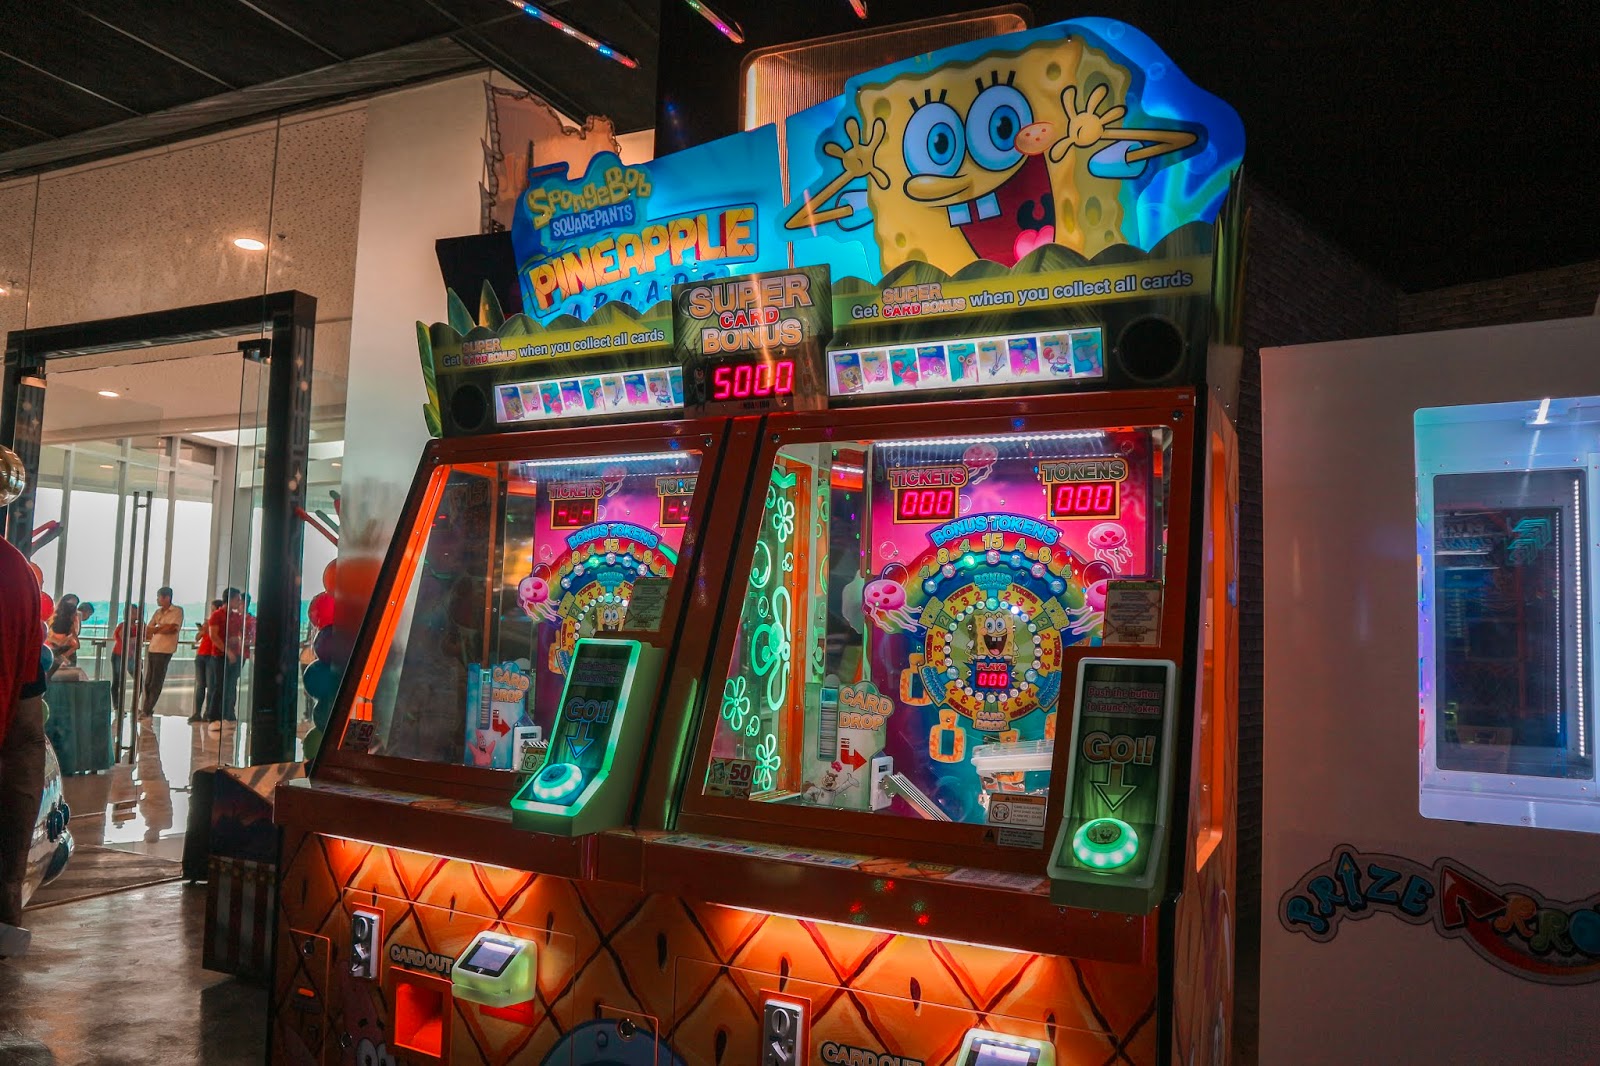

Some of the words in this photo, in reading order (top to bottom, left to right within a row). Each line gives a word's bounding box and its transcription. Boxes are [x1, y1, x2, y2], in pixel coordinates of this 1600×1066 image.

[553, 204, 633, 237] SQUAREPANTS
[529, 207, 755, 310] PINEAPPLE
[688, 273, 814, 319] SUPER
[852, 303, 879, 319] Get
[970, 290, 1014, 307] when
[1017, 287, 1050, 306] you
[1053, 279, 1111, 299] collect
[1115, 275, 1137, 293] all
[1141, 270, 1193, 290] cards
[882, 282, 943, 304] SUPER
[719, 306, 780, 330] CARD
[443, 354, 460, 366] Get
[519, 344, 548, 357] when
[550, 342, 571, 356] you
[573, 335, 611, 351] collect
[613, 331, 628, 346] all
[630, 328, 665, 344] cards
[462, 338, 501, 354] SUPER
[701, 318, 803, 355] BONUS
[714, 361, 795, 399] 5000
[890, 468, 966, 487] TICKETS
[1041, 461, 1126, 482] TOKENS
[550, 482, 603, 498] TICKETS
[1055, 485, 1113, 512] 000
[901, 490, 954, 516] 000
[568, 524, 608, 550] BONUS
[609, 523, 659, 549] TOKENS
[930, 515, 988, 547] BONUS
[988, 515, 1059, 545] TOKENS
[571, 550, 581, 565] 8
[588, 542, 596, 554] 4
[604, 539, 620, 552] 15
[628, 542, 635, 554] 4
[643, 550, 652, 565] 8
[919, 565, 931, 579] 4
[937, 548, 950, 565] 8
[959, 538, 971, 553] 4
[982, 533, 1005, 550] 15
[1014, 538, 1026, 553] 4
[1038, 548, 1052, 564] 8
[1061, 564, 1073, 579] 4
[974, 573, 1012, 586] BONUS
[950, 605, 958, 616] 2
[961, 597, 969, 606] 3
[974, 591, 983, 601] 2
[1003, 591, 1012, 601] 2
[1016, 597, 1025, 606] 3
[1027, 607, 1036, 616] 2
[493, 667, 530, 691] CARD
[976, 662, 1007, 671] PLAYS
[978, 672, 1008, 687] 000
[492, 687, 524, 703] DROP
[840, 686, 893, 716] CARD
[1088, 687, 1111, 698] Push
[1111, 688, 1130, 699] the
[1130, 689, 1160, 700] button
[565, 696, 614, 723] GO!!
[1087, 702, 1097, 712] to
[1098, 702, 1128, 713] launch
[1130, 703, 1160, 714] Token
[839, 711, 885, 731] DROP
[1083, 731, 1156, 766] GO!!
[730, 764, 752, 781] 50
[1287, 852, 1435, 934] PRIZE
[390, 944, 426, 967] CARD
[425, 953, 454, 974] OUT
[822, 1042, 878, 1066] CARD
